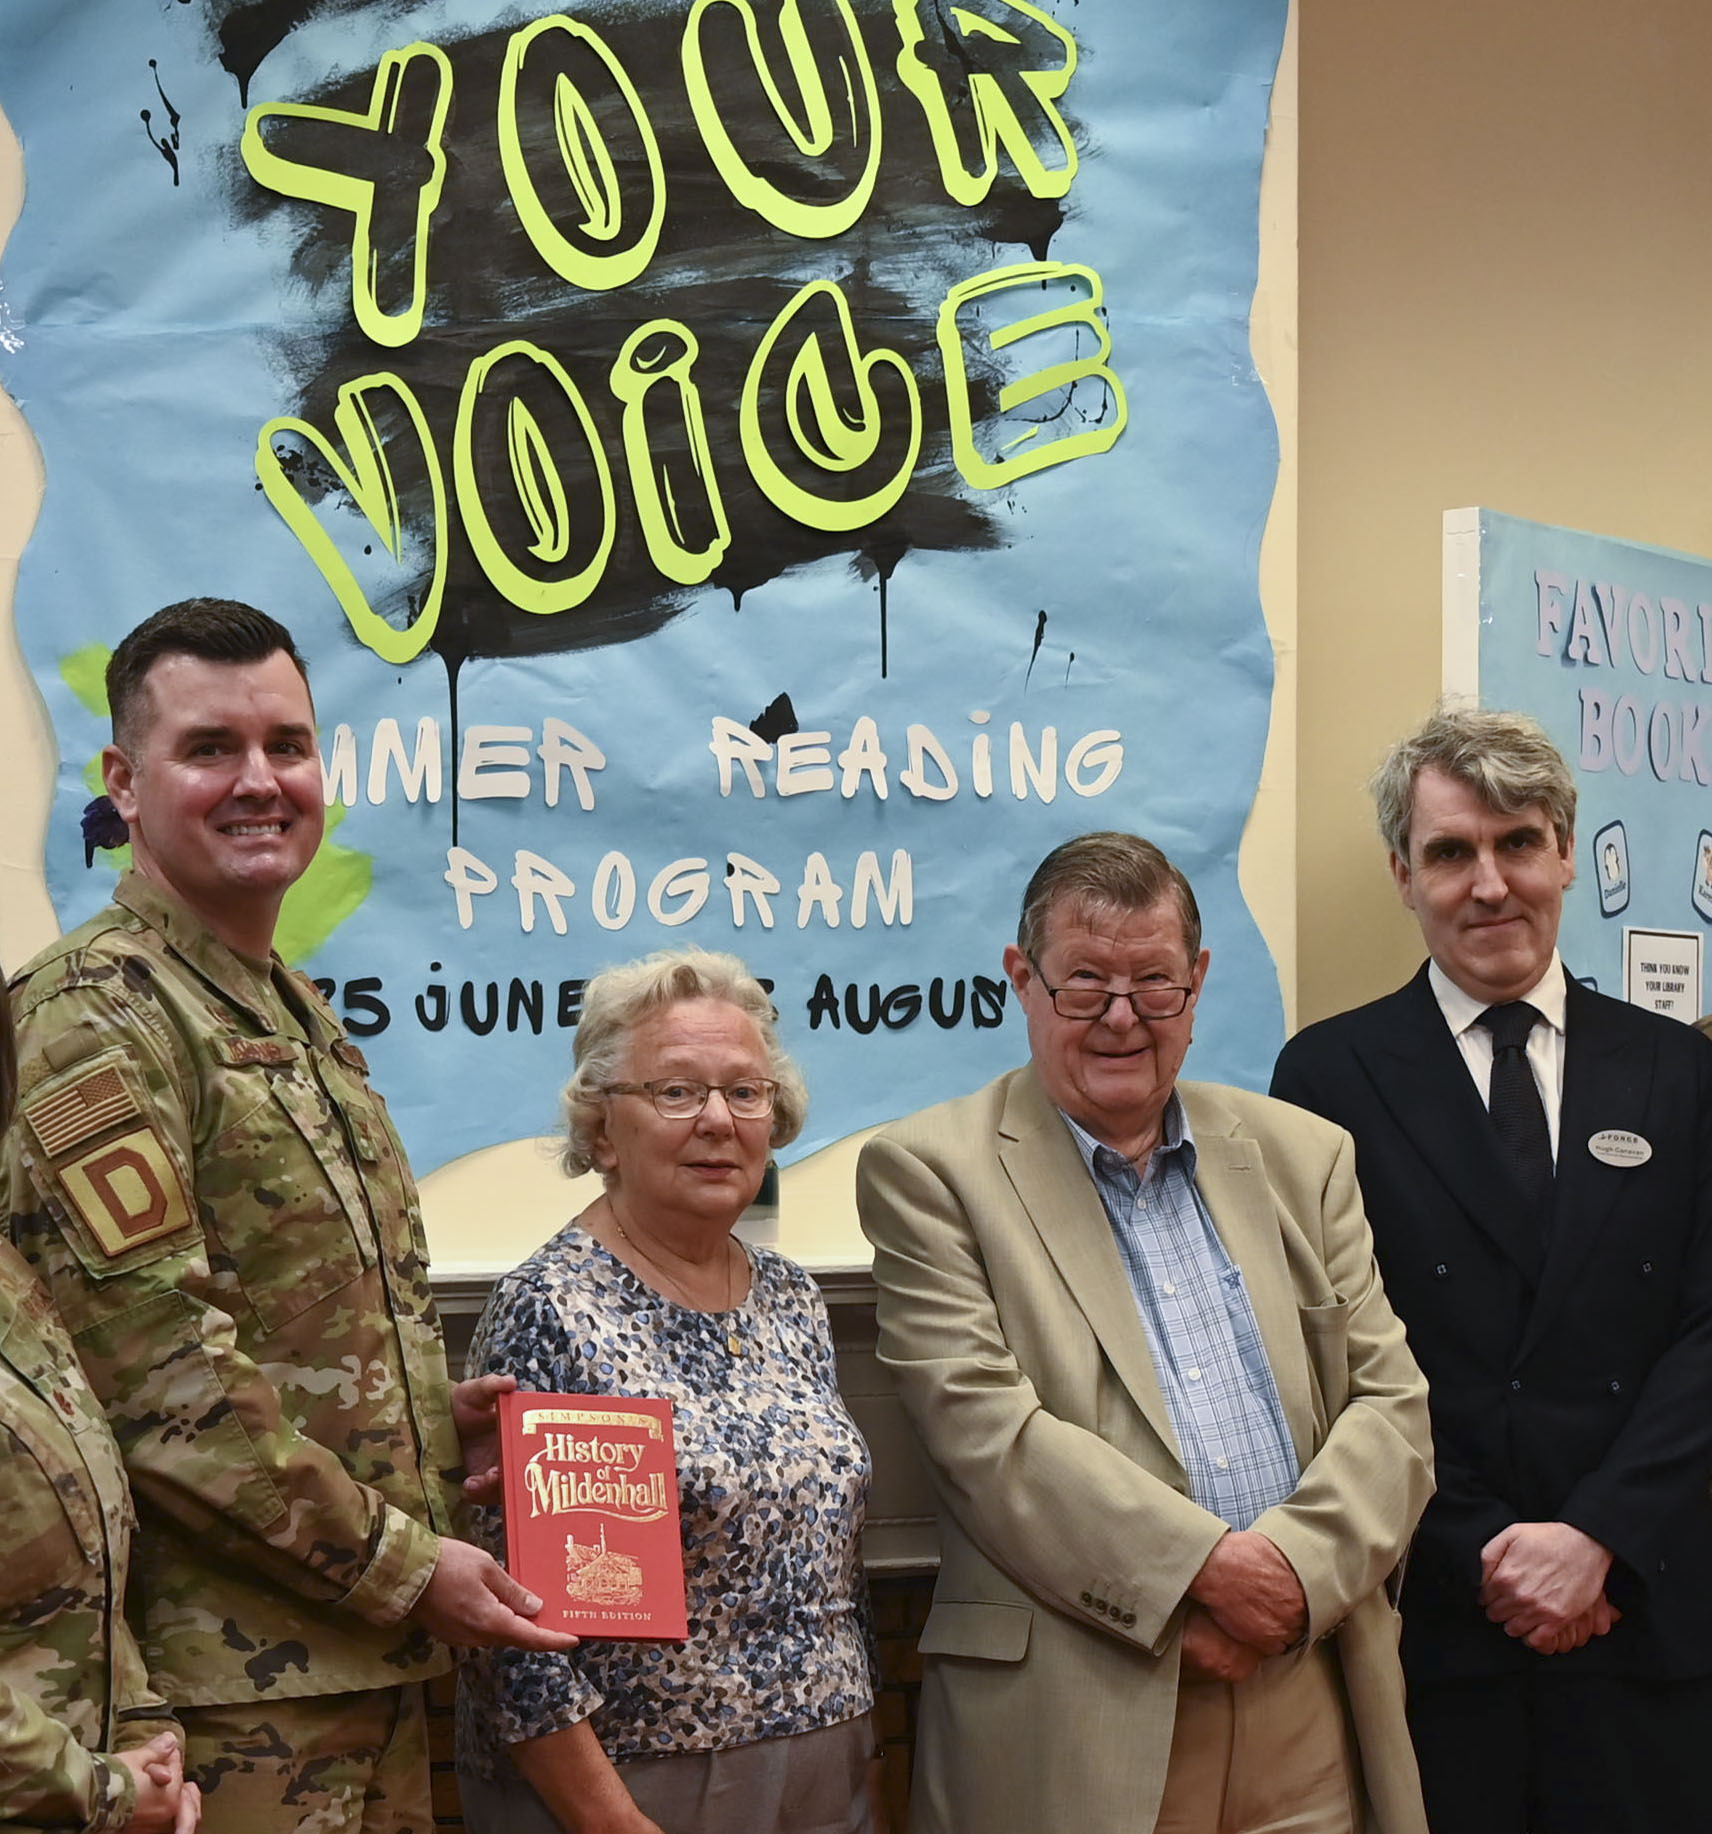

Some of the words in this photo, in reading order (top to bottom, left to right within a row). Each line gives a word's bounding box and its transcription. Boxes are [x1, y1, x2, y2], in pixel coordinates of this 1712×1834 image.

[241, 0, 1078, 348] YOUR
[321, 716, 607, 811] MMER
[443, 845, 914, 936] PROGRAM
[807, 974, 1007, 1035] AUGUS
[1645, 980, 1661, 991] YOUR
[82, 1145, 169, 1239] D
[530, 1432, 646, 1472] History
[597, 1465, 612, 1481] of
[524, 1463, 669, 1522] Mildenhall
[562, 1609, 598, 1620] FIFTH
[601, 1610, 653, 1621] EDITION
